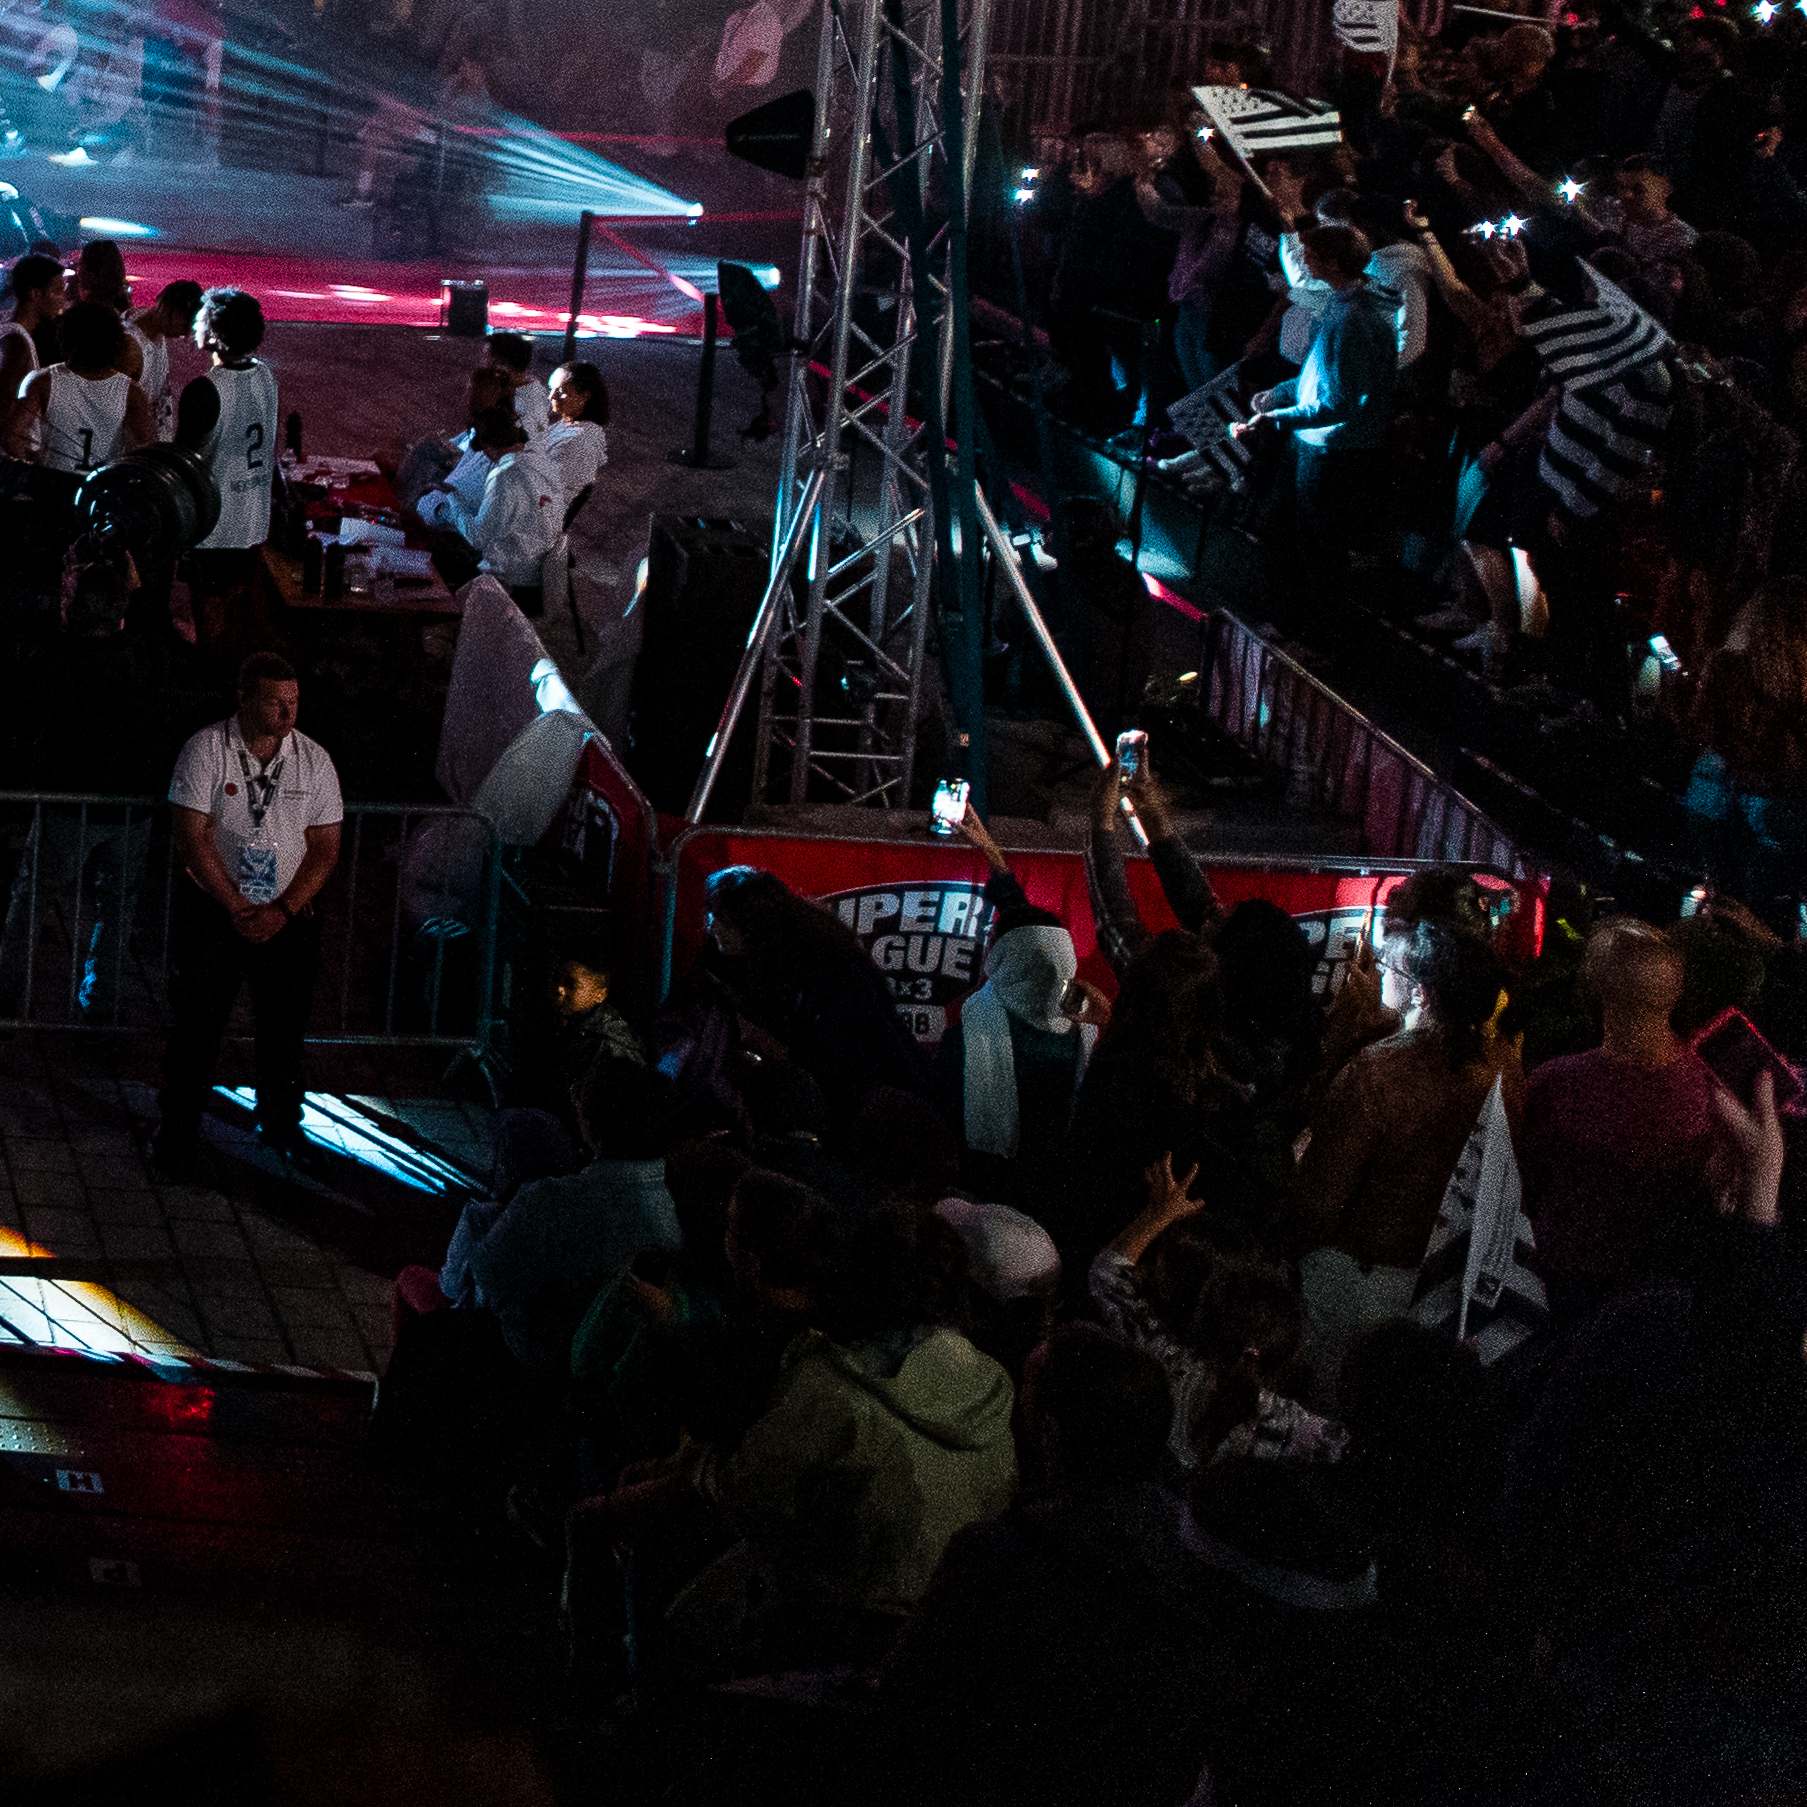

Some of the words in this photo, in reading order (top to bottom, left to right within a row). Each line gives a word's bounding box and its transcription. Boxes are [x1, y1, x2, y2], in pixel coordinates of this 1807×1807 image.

[77, 428, 94, 470] 1
[246, 422, 264, 469] 2
[870, 933, 977, 982] GUE
